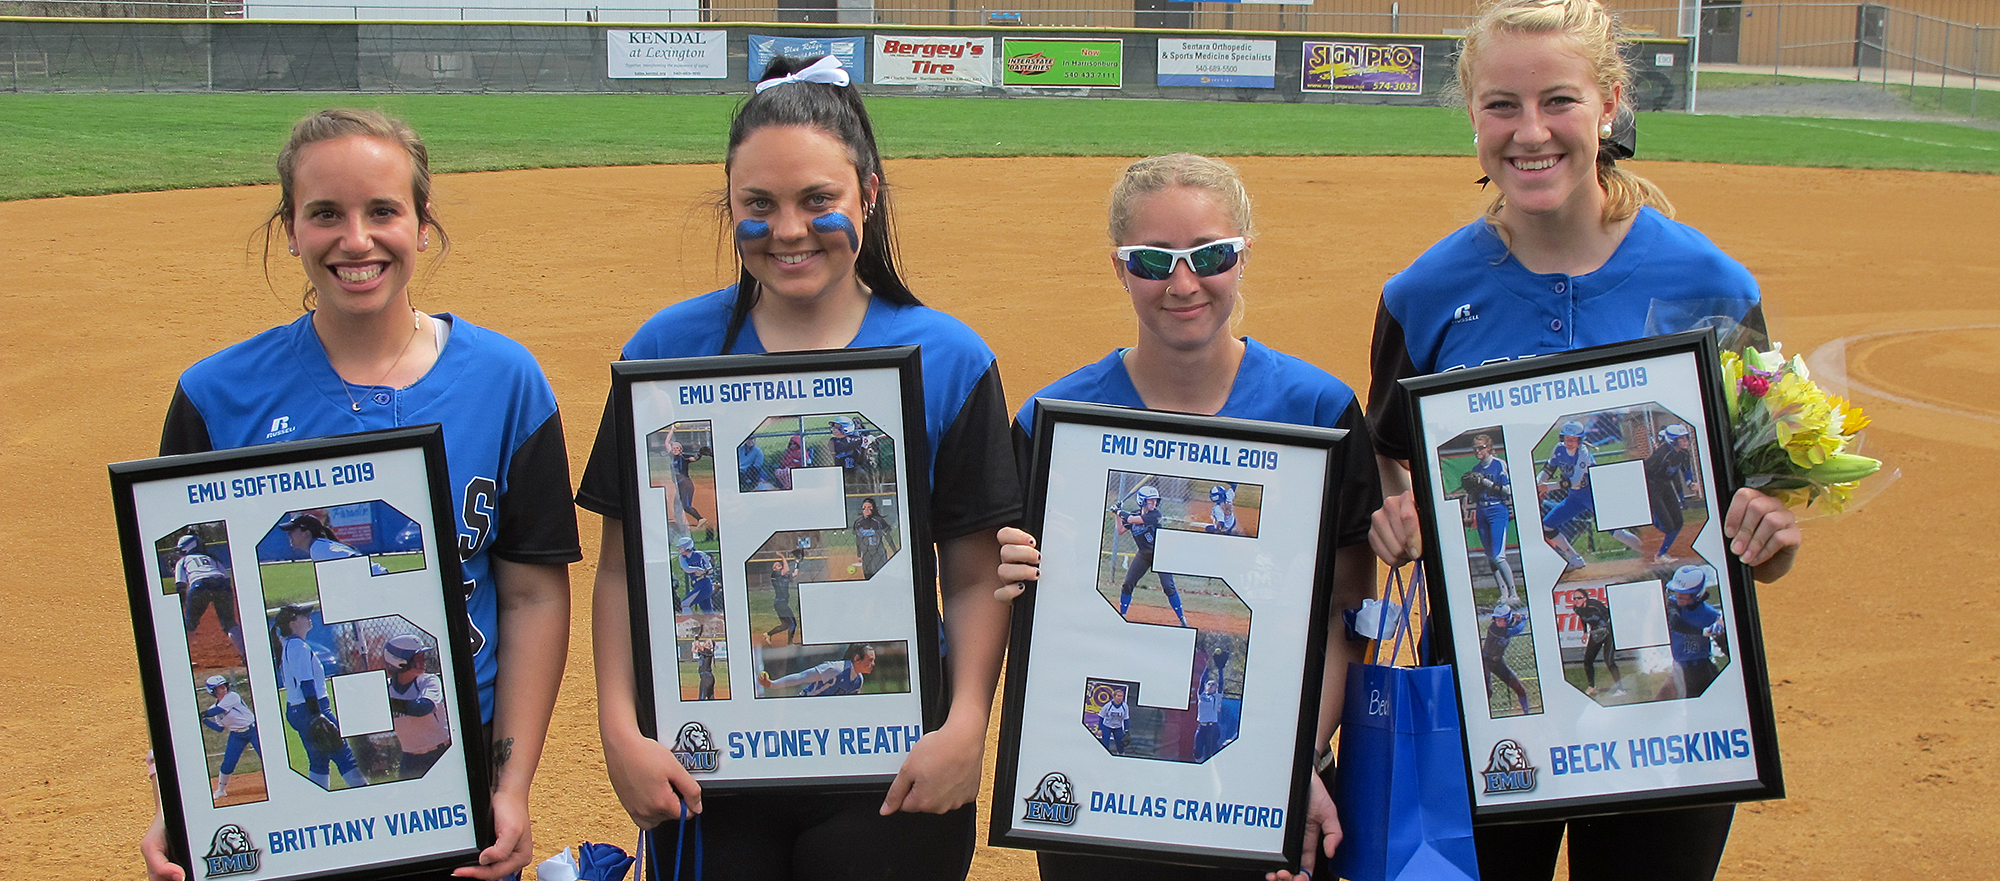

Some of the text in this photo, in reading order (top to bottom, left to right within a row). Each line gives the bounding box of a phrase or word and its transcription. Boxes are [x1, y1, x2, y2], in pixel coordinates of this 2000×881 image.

[628, 32, 706, 44] KENDAL
[883, 40, 984, 58] Bergey's
[1212, 43, 1252, 52] Orthopedic
[629, 47, 705, 61] at Lexington
[1072, 60, 1118, 68] Harrisonburg
[1170, 52, 1193, 61] Sports
[1195, 52, 1229, 60] Medicine
[1231, 53, 1271, 62] Specialists
[1309, 45, 1413, 69] SIGN PRO
[912, 60, 954, 74] Tire
[1195, 65, 1238, 73] 540-689-5500
[1372, 81, 1417, 91] 574-3032
[679, 377, 853, 405] EMU SOFTBALL 2019
[1467, 366, 1648, 413] EMU SOFTBALL 2019
[1102, 434, 1278, 470] EMU SOFTBALL 2019
[187, 462, 375, 504] EMU SOFTBALL 2019
[645, 411, 911, 702] 12
[1436, 401, 1731, 719] 18
[1081, 469, 1264, 764] 5
[154, 499, 452, 809] 16
[728, 725, 920, 759] SYDNEY REATH
[1550, 728, 1750, 775] BECK HOSKINS
[1487, 769, 1534, 791] EMU
[1028, 802, 1075, 822] EMU
[1090, 791, 1284, 828] DALLAS CRAWFORD
[268, 804, 468, 854] BRITTANY VIANDS
[208, 851, 258, 873] EMU
